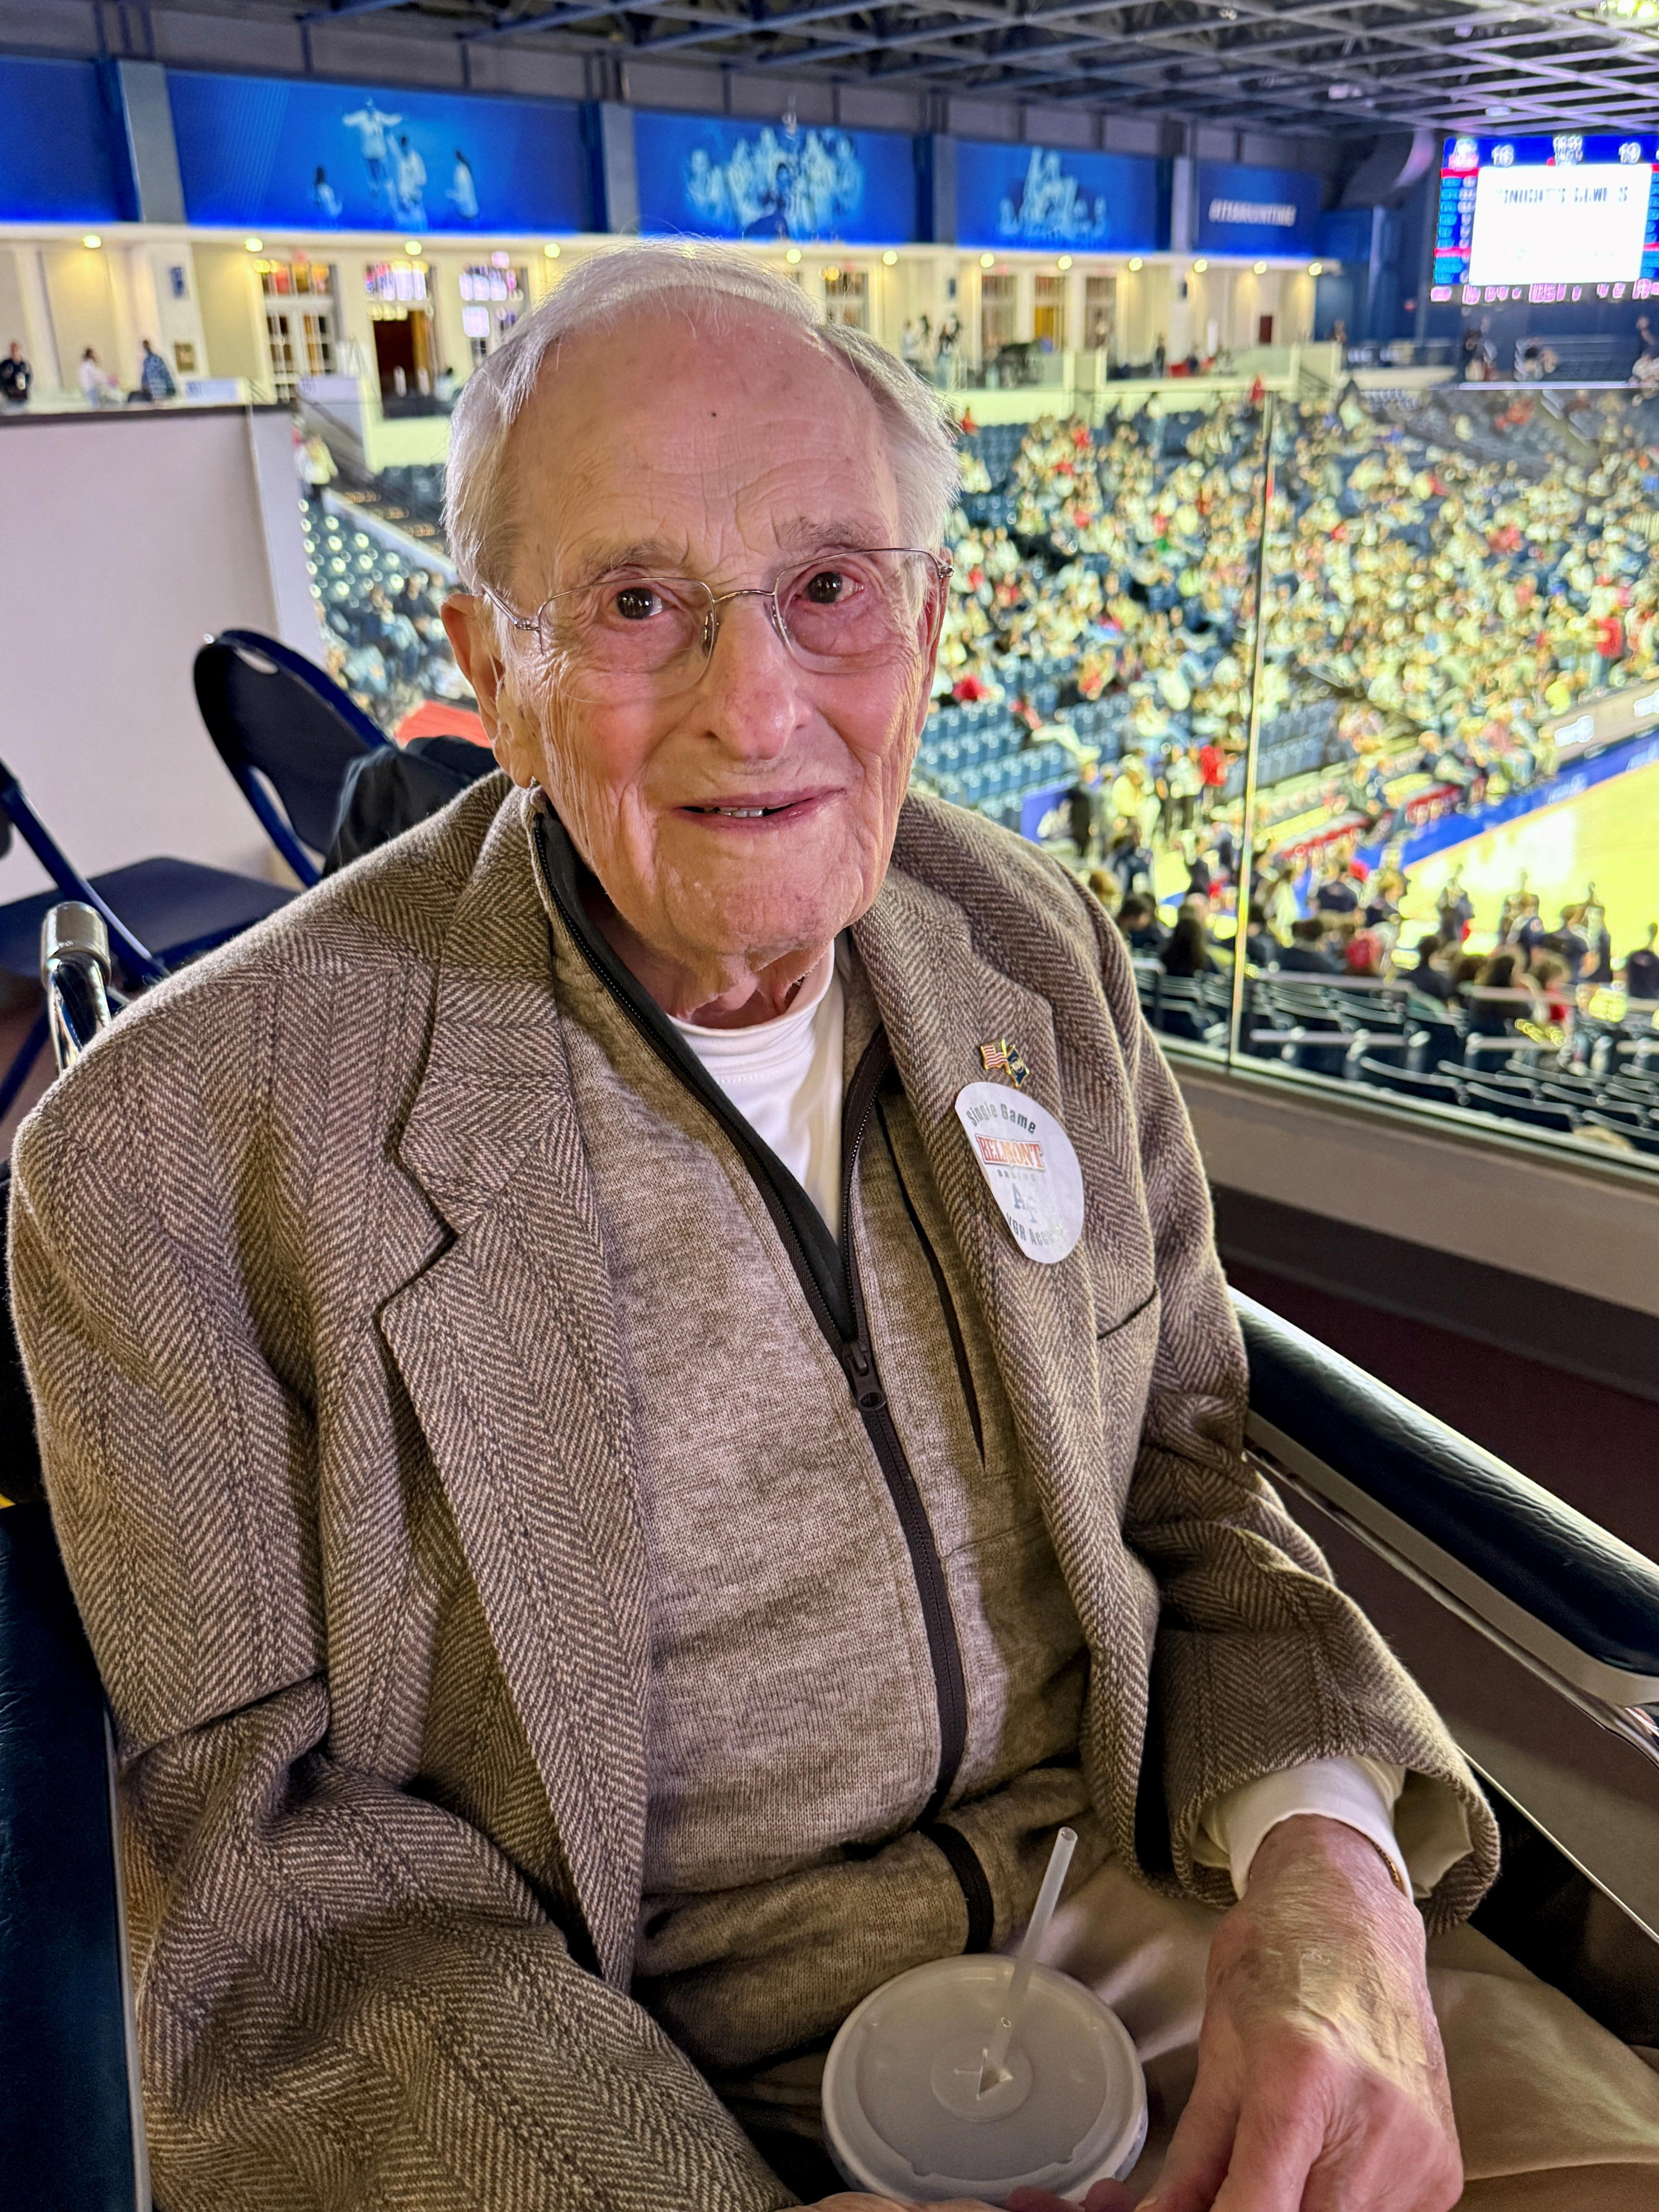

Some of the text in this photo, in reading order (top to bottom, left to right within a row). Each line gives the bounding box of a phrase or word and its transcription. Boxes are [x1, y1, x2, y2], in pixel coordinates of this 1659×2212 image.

[966, 1102, 1036, 1134] Single Game
[976, 1136, 1044, 1168] BELMONT
